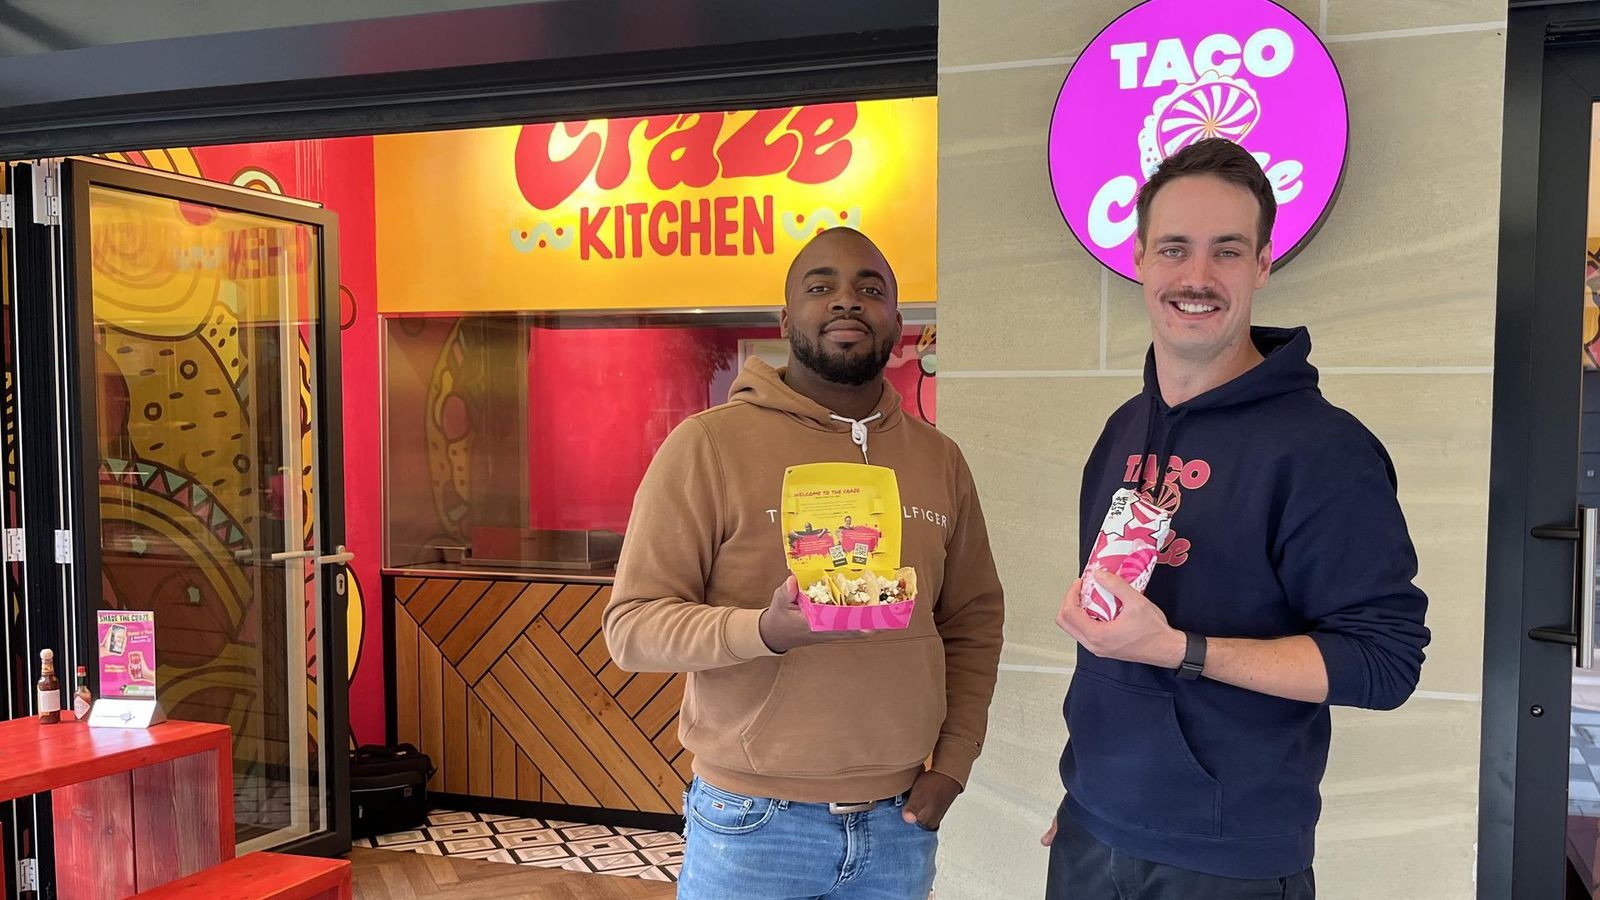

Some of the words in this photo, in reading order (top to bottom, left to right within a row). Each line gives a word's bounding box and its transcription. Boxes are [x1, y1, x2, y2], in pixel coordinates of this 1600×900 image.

[1110, 28, 1294, 89] TACO
[515, 102, 858, 211] Craze
[579, 195, 774, 260] KITCHEN
[1123, 454, 1211, 489] TACO
